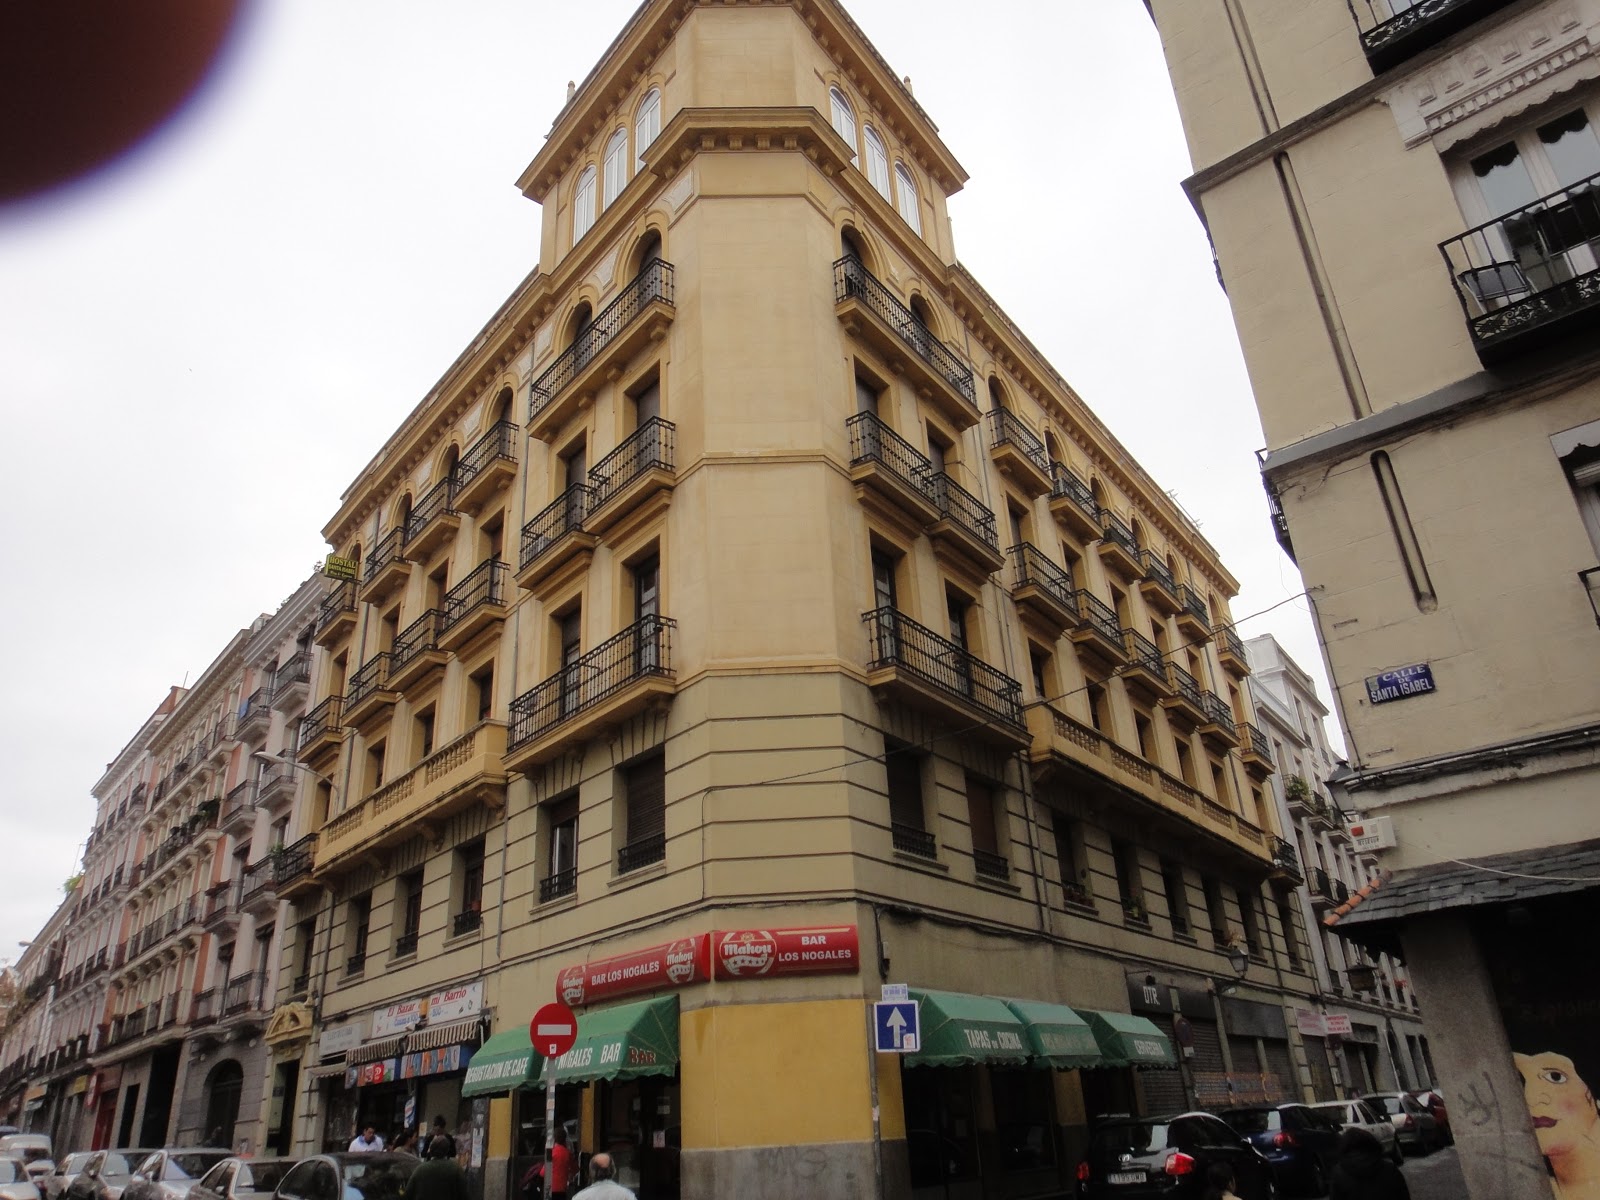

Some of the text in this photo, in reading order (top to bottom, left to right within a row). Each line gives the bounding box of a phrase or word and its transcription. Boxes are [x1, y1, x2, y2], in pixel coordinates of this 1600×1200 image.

[329, 556, 356, 568] HOSTAL
[1382, 665, 1425, 681] CALLE
[1370, 678, 1433, 703] SANTA ISABEL
[724, 942, 772, 956] Mahou
[801, 935, 826, 946] BAR
[666, 950, 693, 965] Mahou
[778, 949, 851, 962] LOS NOGALES
[562, 975, 584, 989] Mahou
[591, 961, 660, 986] BAR LOS NOGALES
[397, 1003, 416, 1014] Bazar
[430, 992, 442, 1005] mi
[444, 987, 467, 1002] Barrio
[964, 1029, 991, 1049] TAPAS
[997, 1031, 1023, 1049] COCINA
[600, 1042, 621, 1064] BAR
[628, 1045, 656, 1065] BAR
[464, 1061, 505, 1083] DEGUSTACION
[502, 1060, 513, 1077] DE
[511, 1057, 529, 1076] CAFE
